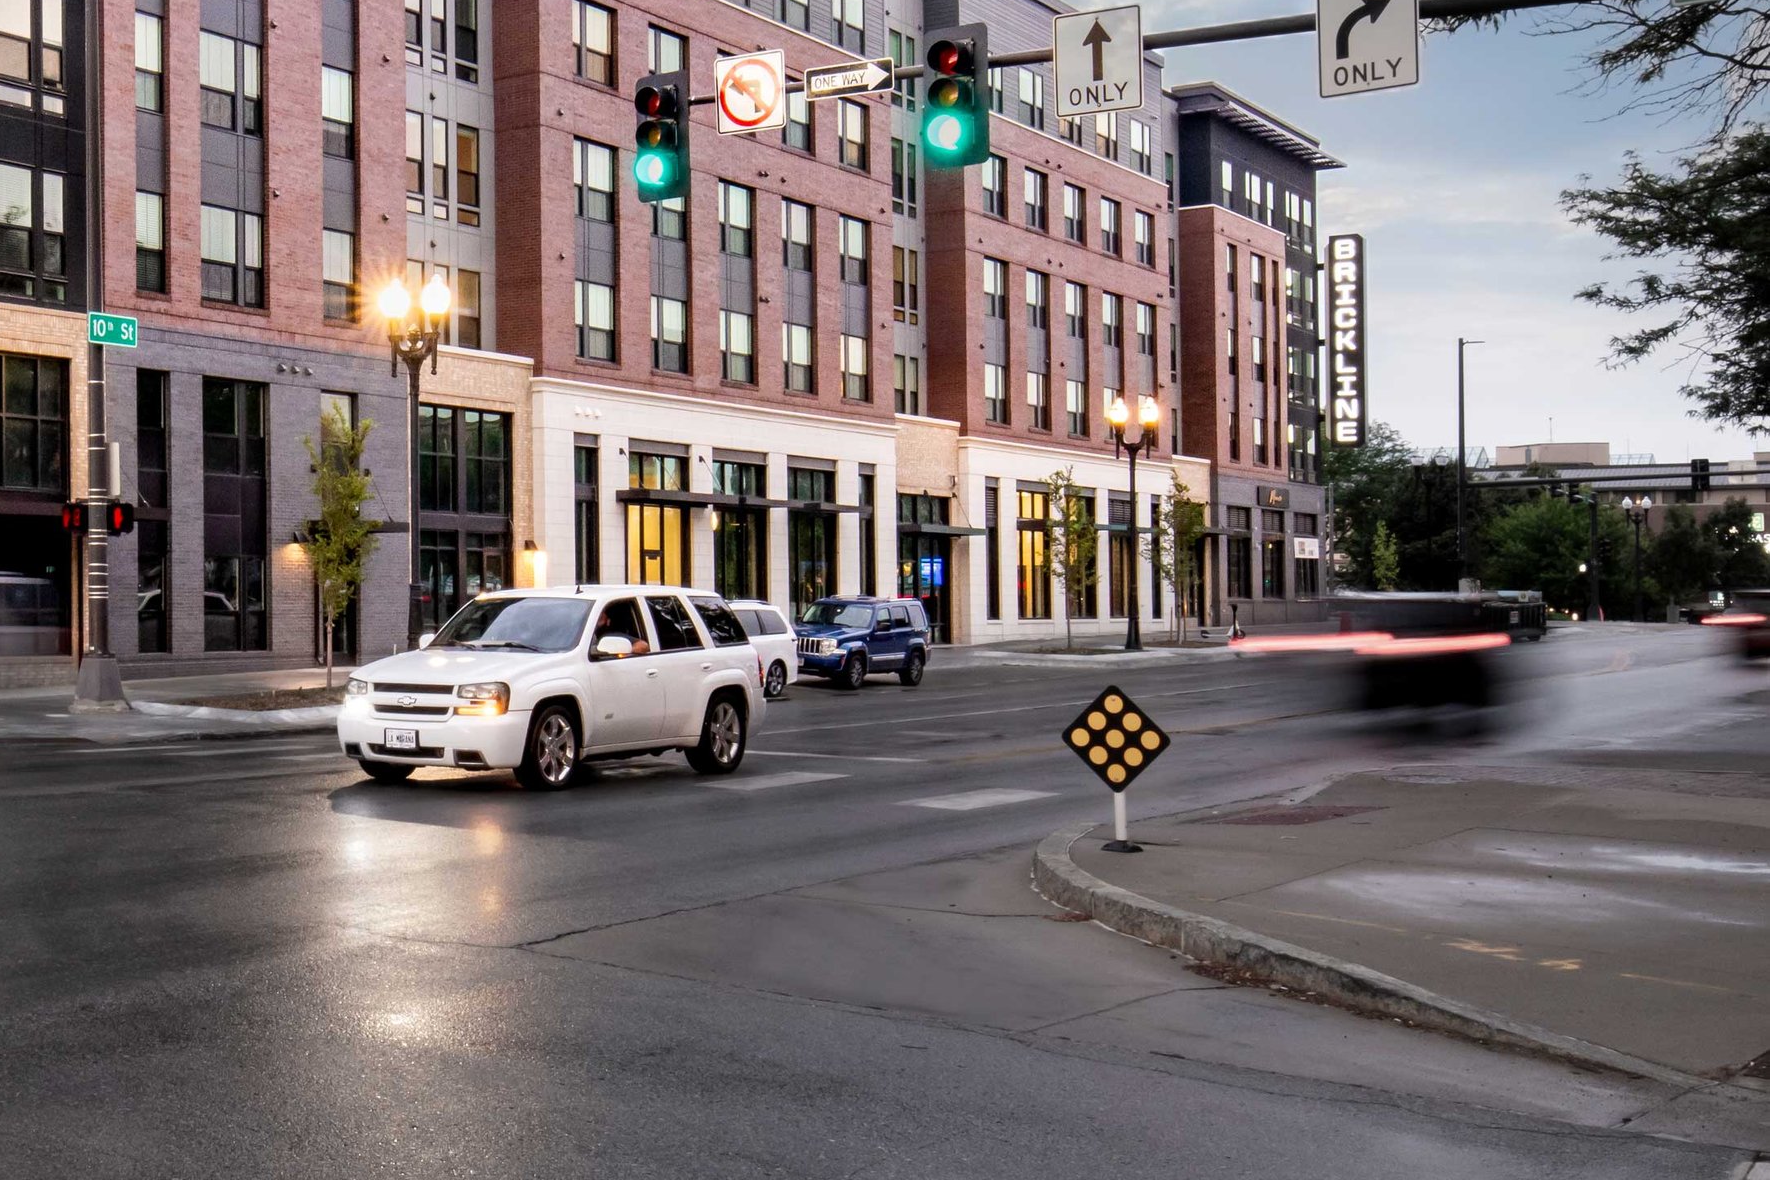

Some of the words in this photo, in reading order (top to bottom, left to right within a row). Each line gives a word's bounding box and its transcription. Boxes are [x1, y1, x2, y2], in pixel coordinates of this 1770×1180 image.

[814, 75, 838, 89] ONE
[842, 71, 865, 85] WAY
[1334, 57, 1402, 86] ONLY
[1069, 81, 1128, 106] ONLY
[120, 322, 134, 340] St
[1334, 238, 1359, 442] BRICKLINE
